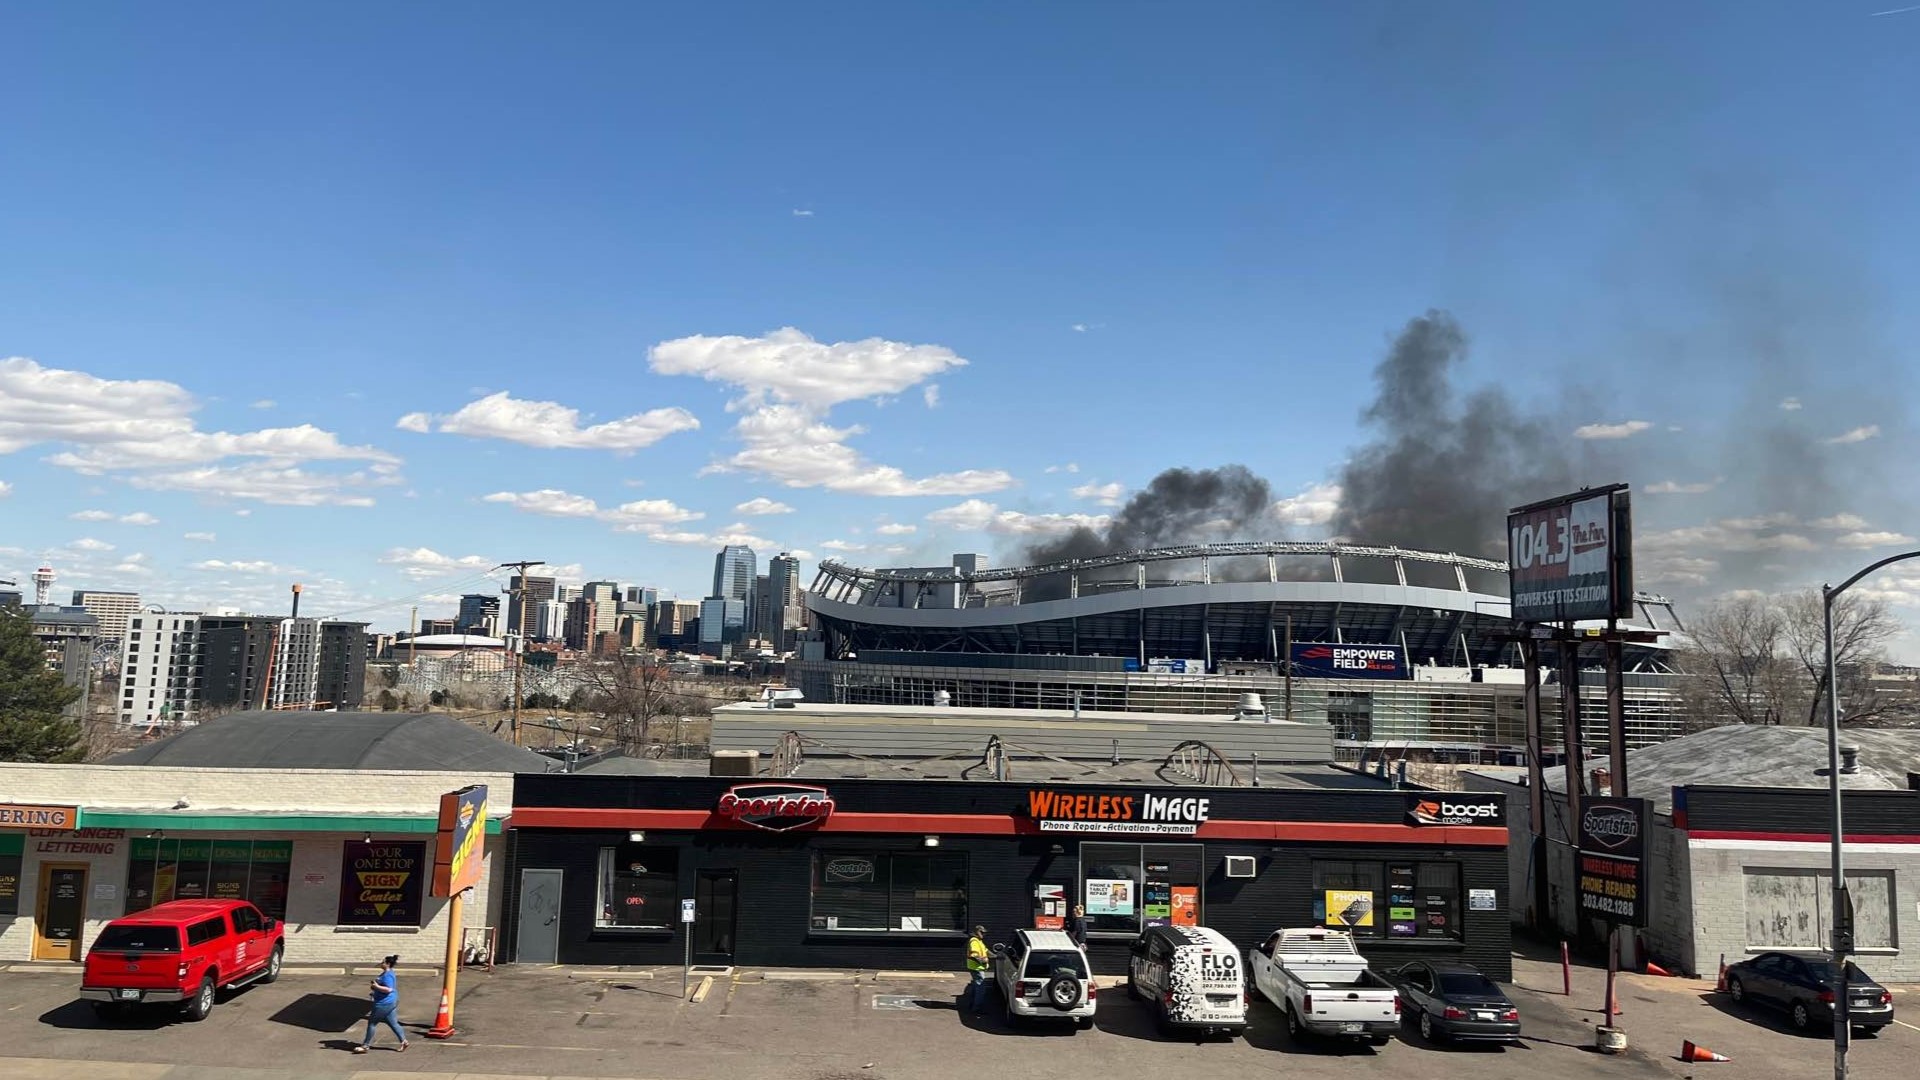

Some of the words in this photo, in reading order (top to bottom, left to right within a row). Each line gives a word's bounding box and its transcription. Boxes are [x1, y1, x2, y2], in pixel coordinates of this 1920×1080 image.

[1572, 524, 1588, 543] The
[1588, 521, 1607, 542] Fan
[1511, 517, 1570, 569] 104.3
[1515, 591, 1547, 607] DENVER'S
[1575, 585, 1608, 602] STATION
[1333, 649, 1395, 660] EMPOWER
[1333, 660, 1367, 669] FIELD
[720, 794, 834, 820] Sportsfan
[1029, 790, 1133, 820] WIRELESS
[1142, 793, 1209, 821] IMAGE
[1441, 801, 1498, 817] boost
[1043, 821, 1070, 830] Phone
[1073, 822, 1100, 831] Repair
[1107, 823, 1150, 832] Activation
[1156, 824, 1193, 833] Payment
[1583, 812, 1638, 837] Sportsfan
[29, 828, 67, 838] CLIFF
[72, 828, 125, 839] SINGER
[37, 841, 115, 854] LETTERING
[451, 799, 487, 885] SIGNS
[368, 847, 402, 858] YOUR
[354, 859, 380, 869] ONE
[384, 859, 414, 869] STOP
[827, 863, 873, 874] Sportsfan
[363, 874, 401, 887] SIGN
[1581, 876, 1603, 894] PHONE
[1605, 880, 1636, 900] REPAIRS
[359, 889, 403, 902] Center
[626, 897, 644, 905] OPEN
[1172, 894, 1183, 908] 3
[1333, 892, 1369, 902] PHONE
[1582, 893, 1634, 916] 303.482.1288
[354, 908, 376, 916] SINCE
[1202, 954, 1236, 969] FLO
